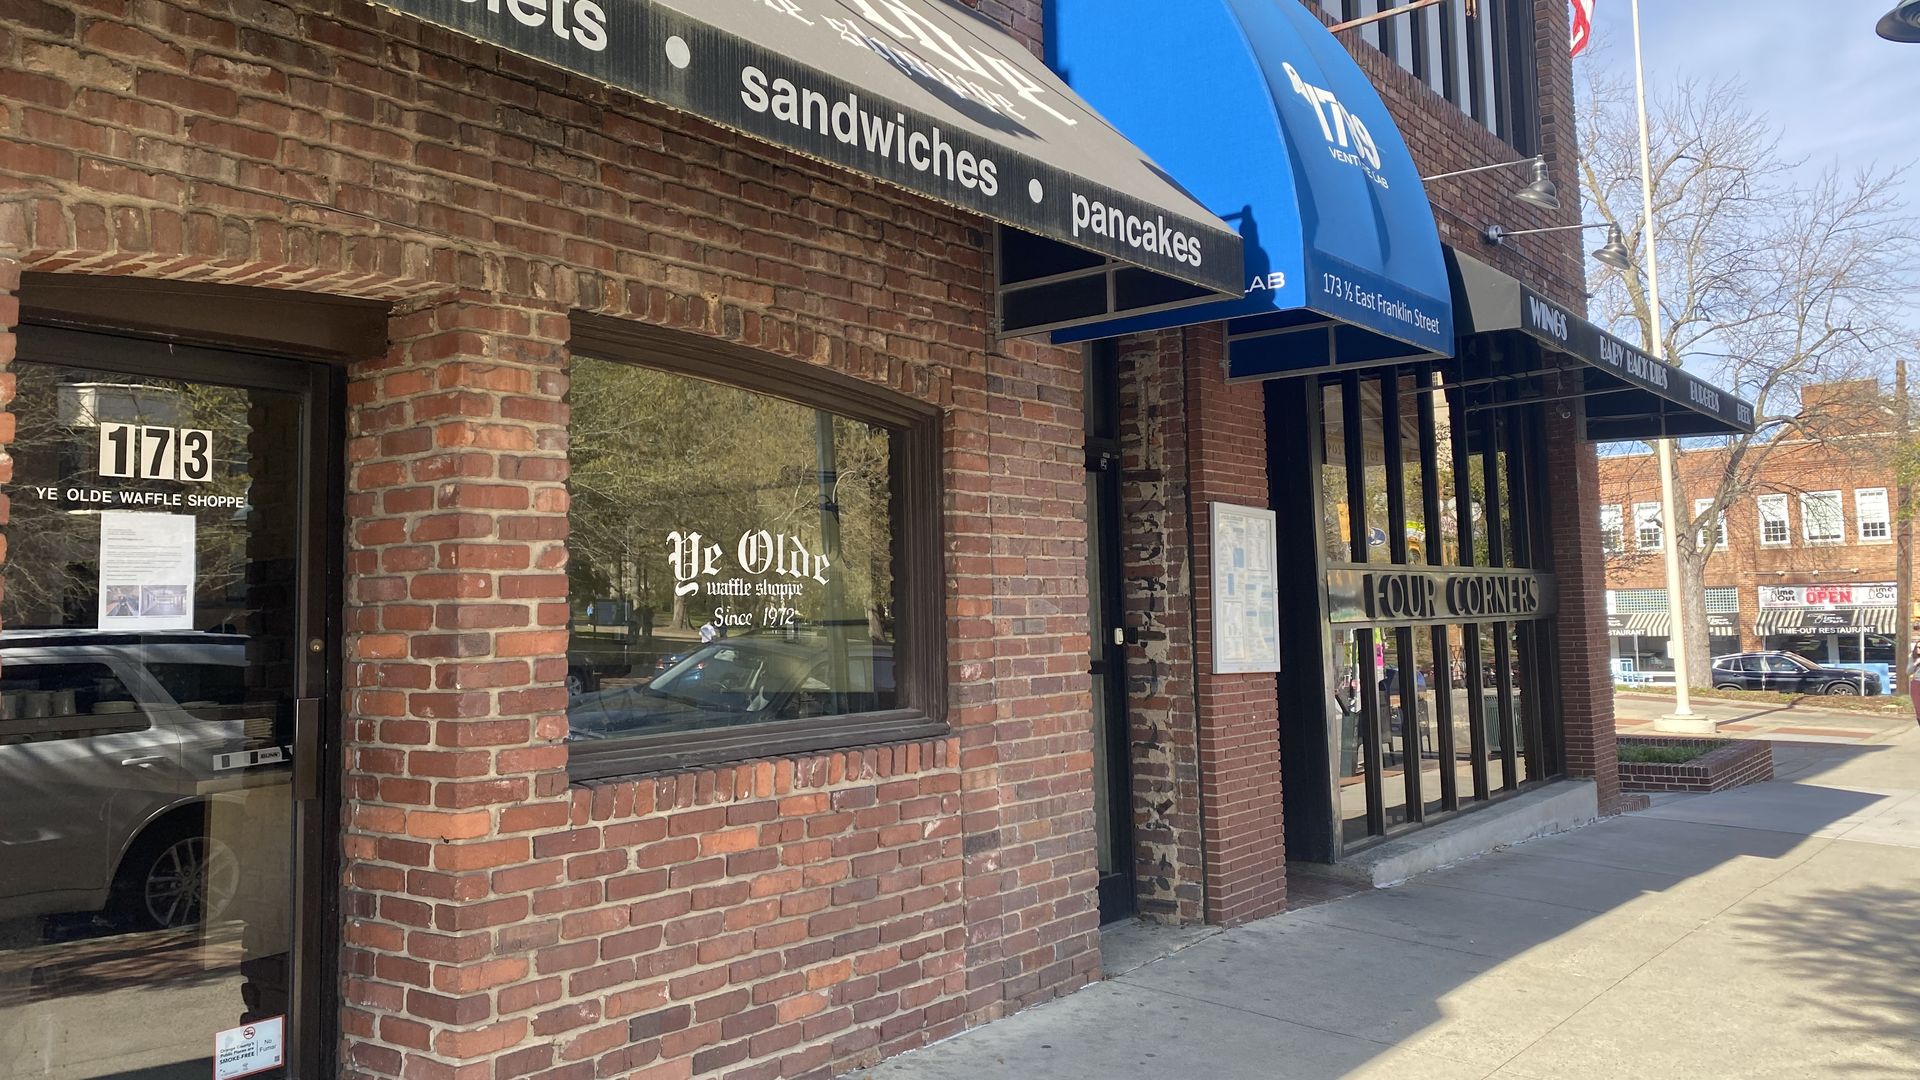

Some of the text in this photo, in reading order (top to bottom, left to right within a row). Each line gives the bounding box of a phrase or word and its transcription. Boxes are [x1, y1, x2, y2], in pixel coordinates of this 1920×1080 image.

[741, 65, 1202, 267] sandwiches pancakes
[1328, 146, 1373, 179] VENTE
[1245, 271, 1286, 293] AB
[1323, 272, 1343, 298] 173
[1355, 285, 1376, 310] East
[1377, 293, 1413, 325] Franklin
[1414, 308, 1440, 335] Street
[1529, 296, 1568, 341] WINGS
[1599, 335, 1625, 368] BABY
[1627, 349, 1650, 380] BACK
[108, 426, 209, 480] 173
[35, 487, 244, 508] YE OLDE WAFFLE SHOPPE
[665, 529, 831, 597] Ye Olde
[706, 578, 803, 600] waffle shoppe
[1363, 574, 1540, 618] FOUR CORNERS
[1806, 591, 1852, 605] OPEN
[714, 606, 795, 627] Since 1972
[1607, 629, 1646, 637] STAURANT
